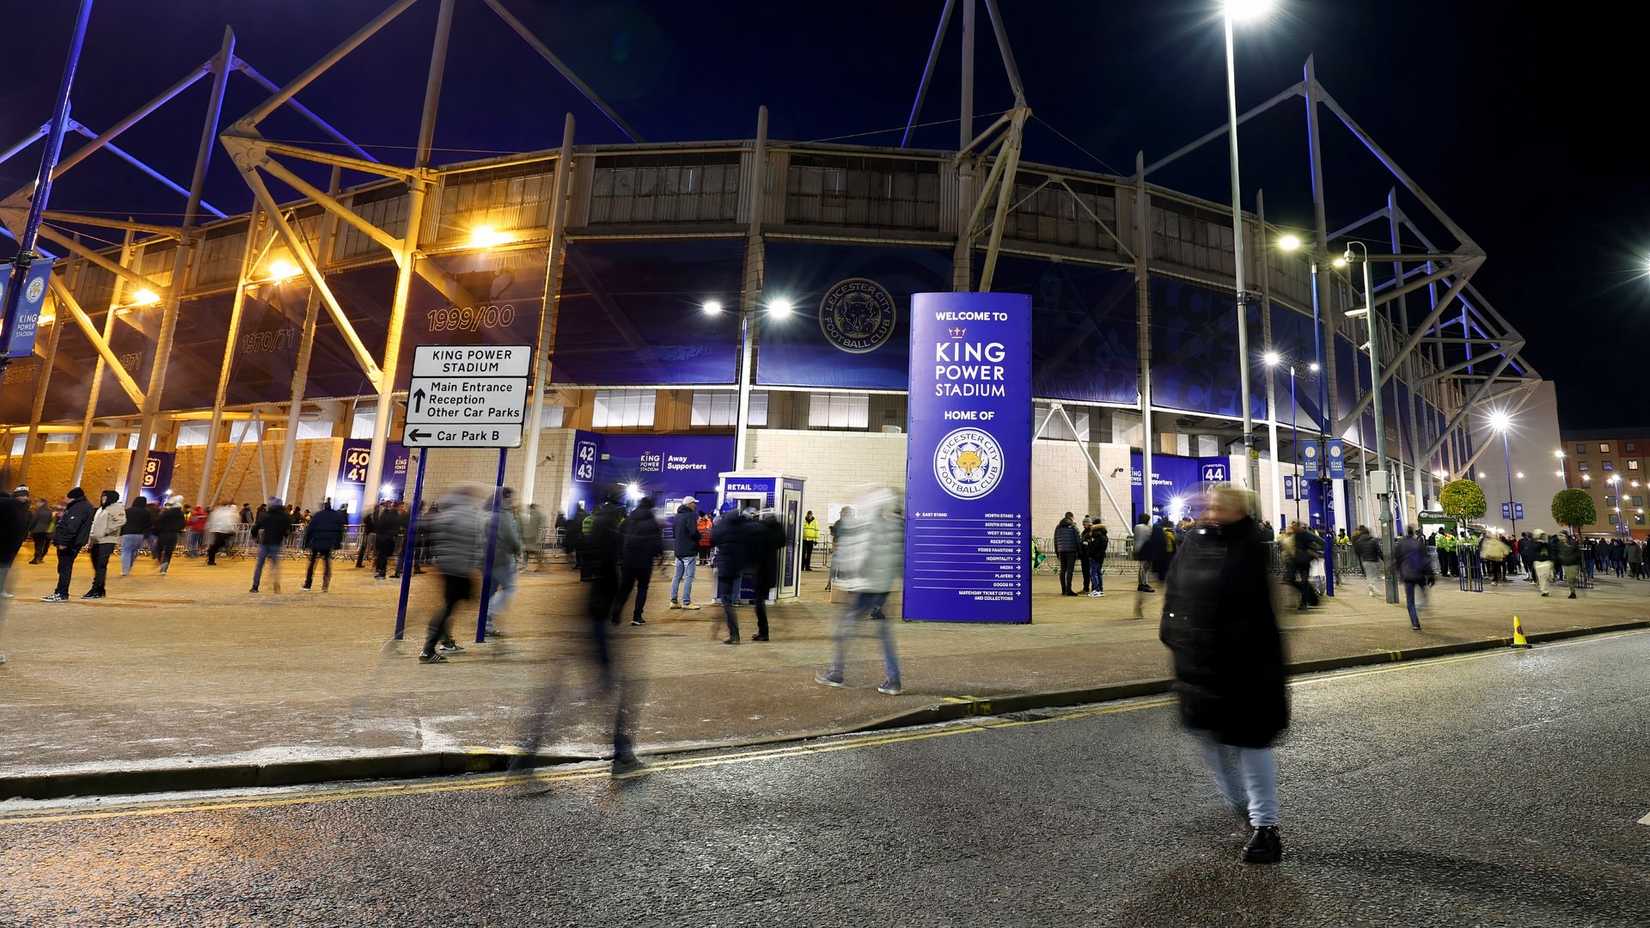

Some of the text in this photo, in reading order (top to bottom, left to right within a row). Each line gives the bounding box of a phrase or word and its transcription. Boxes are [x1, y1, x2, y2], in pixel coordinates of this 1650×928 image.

[826, 283, 890, 313] LEICESTER CITY
[20, 313, 37, 323] KING
[427, 304, 515, 332] 1999/00
[935, 312, 1008, 321] WELCOME TO
[825, 317, 890, 348] FOOTBALL CLUB
[432, 350, 512, 360] KING POWER
[936, 342, 1006, 363] KING
[442, 363, 499, 372] STADIUM
[935, 365, 1004, 381] POWER
[430, 382, 513, 392] Main Entrance
[935, 384, 1006, 397] STADIUM
[428, 395, 485, 406] Reception
[427, 408, 520, 418] Other Car Parks
[944, 411, 995, 421] HOME OF
[437, 431, 500, 441] Car Park B
[940, 433, 998, 461] LEICESTER CITY
[348, 452, 369, 466] 40
[580, 446, 594, 461] 42
[668, 455, 688, 463] Away
[578, 464, 592, 479] 43
[667, 462, 707, 471] Supporters
[348, 468, 366, 481] 41
[940, 466, 998, 494] FOOTBALL CLUB
[1205, 468, 1223, 480] 44
